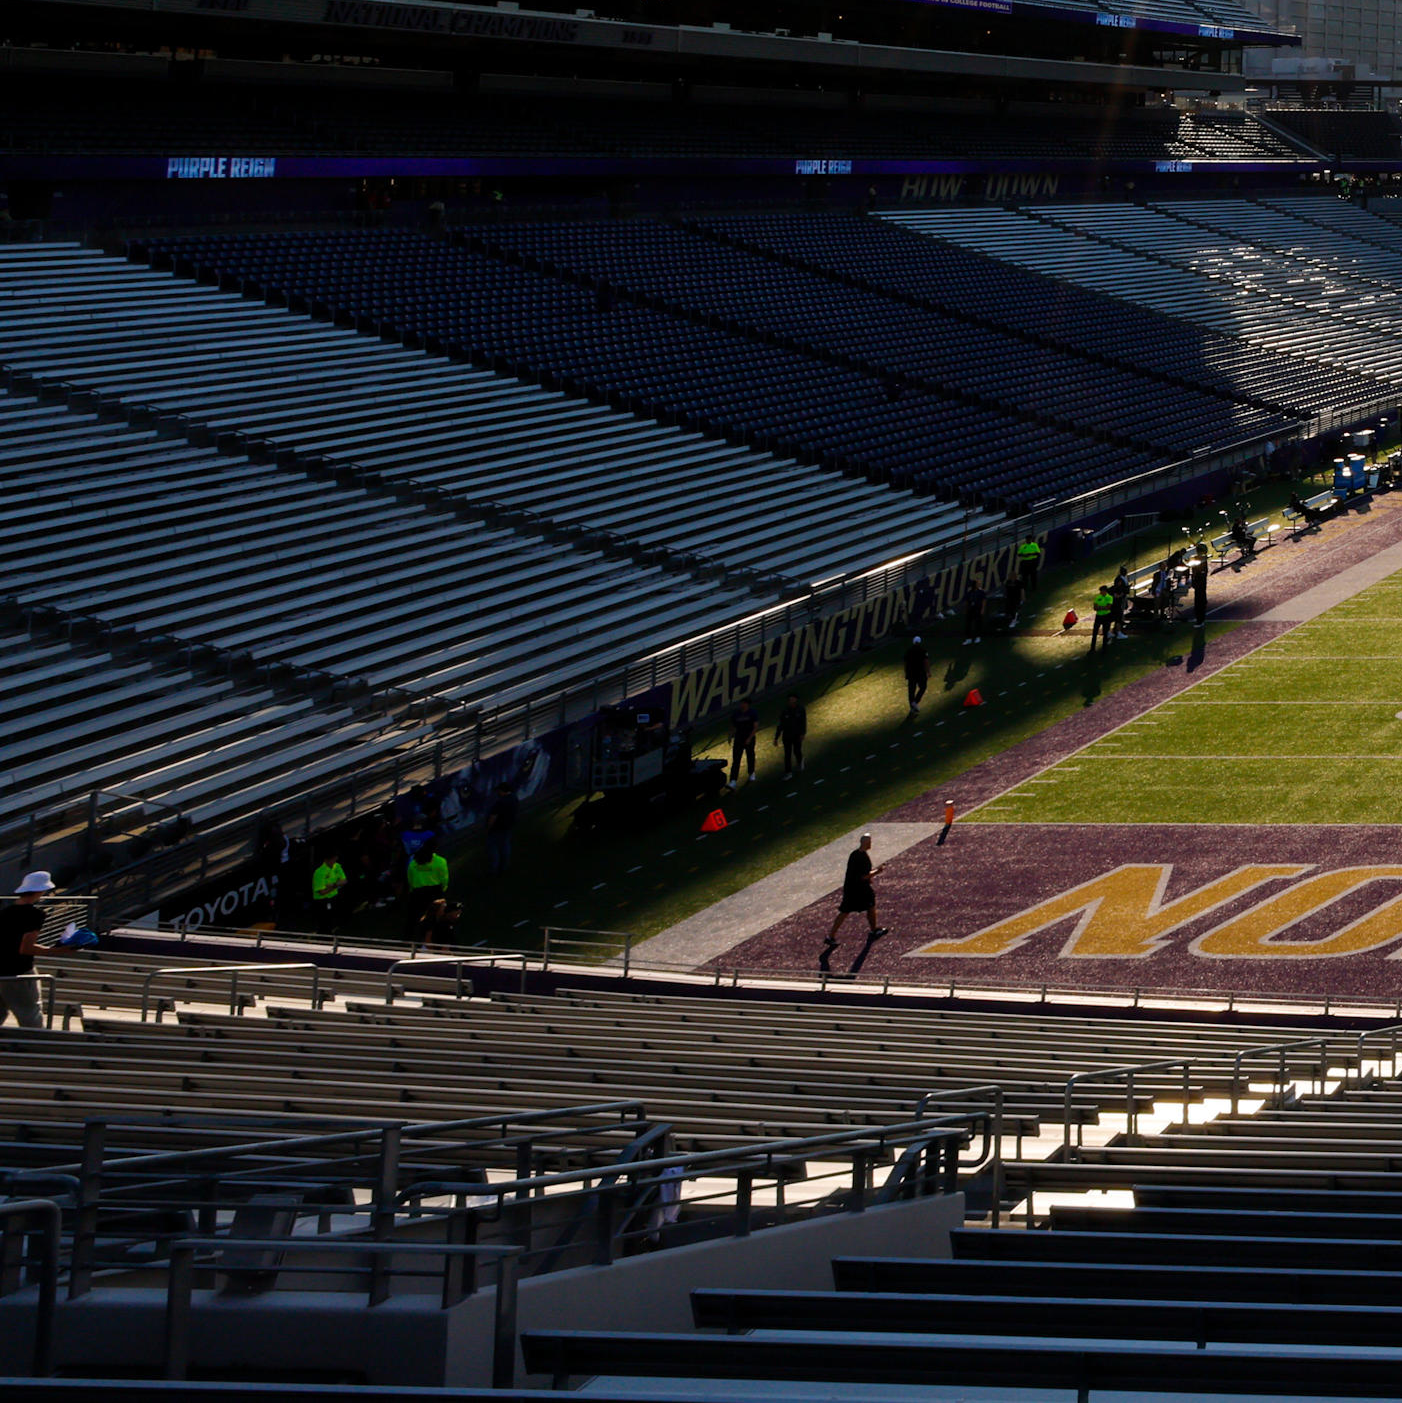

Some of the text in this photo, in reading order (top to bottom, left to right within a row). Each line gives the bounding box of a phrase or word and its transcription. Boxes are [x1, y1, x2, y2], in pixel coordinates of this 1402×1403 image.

[979, 0, 1011, 11] FOOTBALL
[453, 10, 578, 41] CHAMPIONS
[167, 157, 276, 178] PURPLE REIGN
[669, 583, 915, 730] WASHINGTON
[167, 875, 270, 934] TOYOTA
